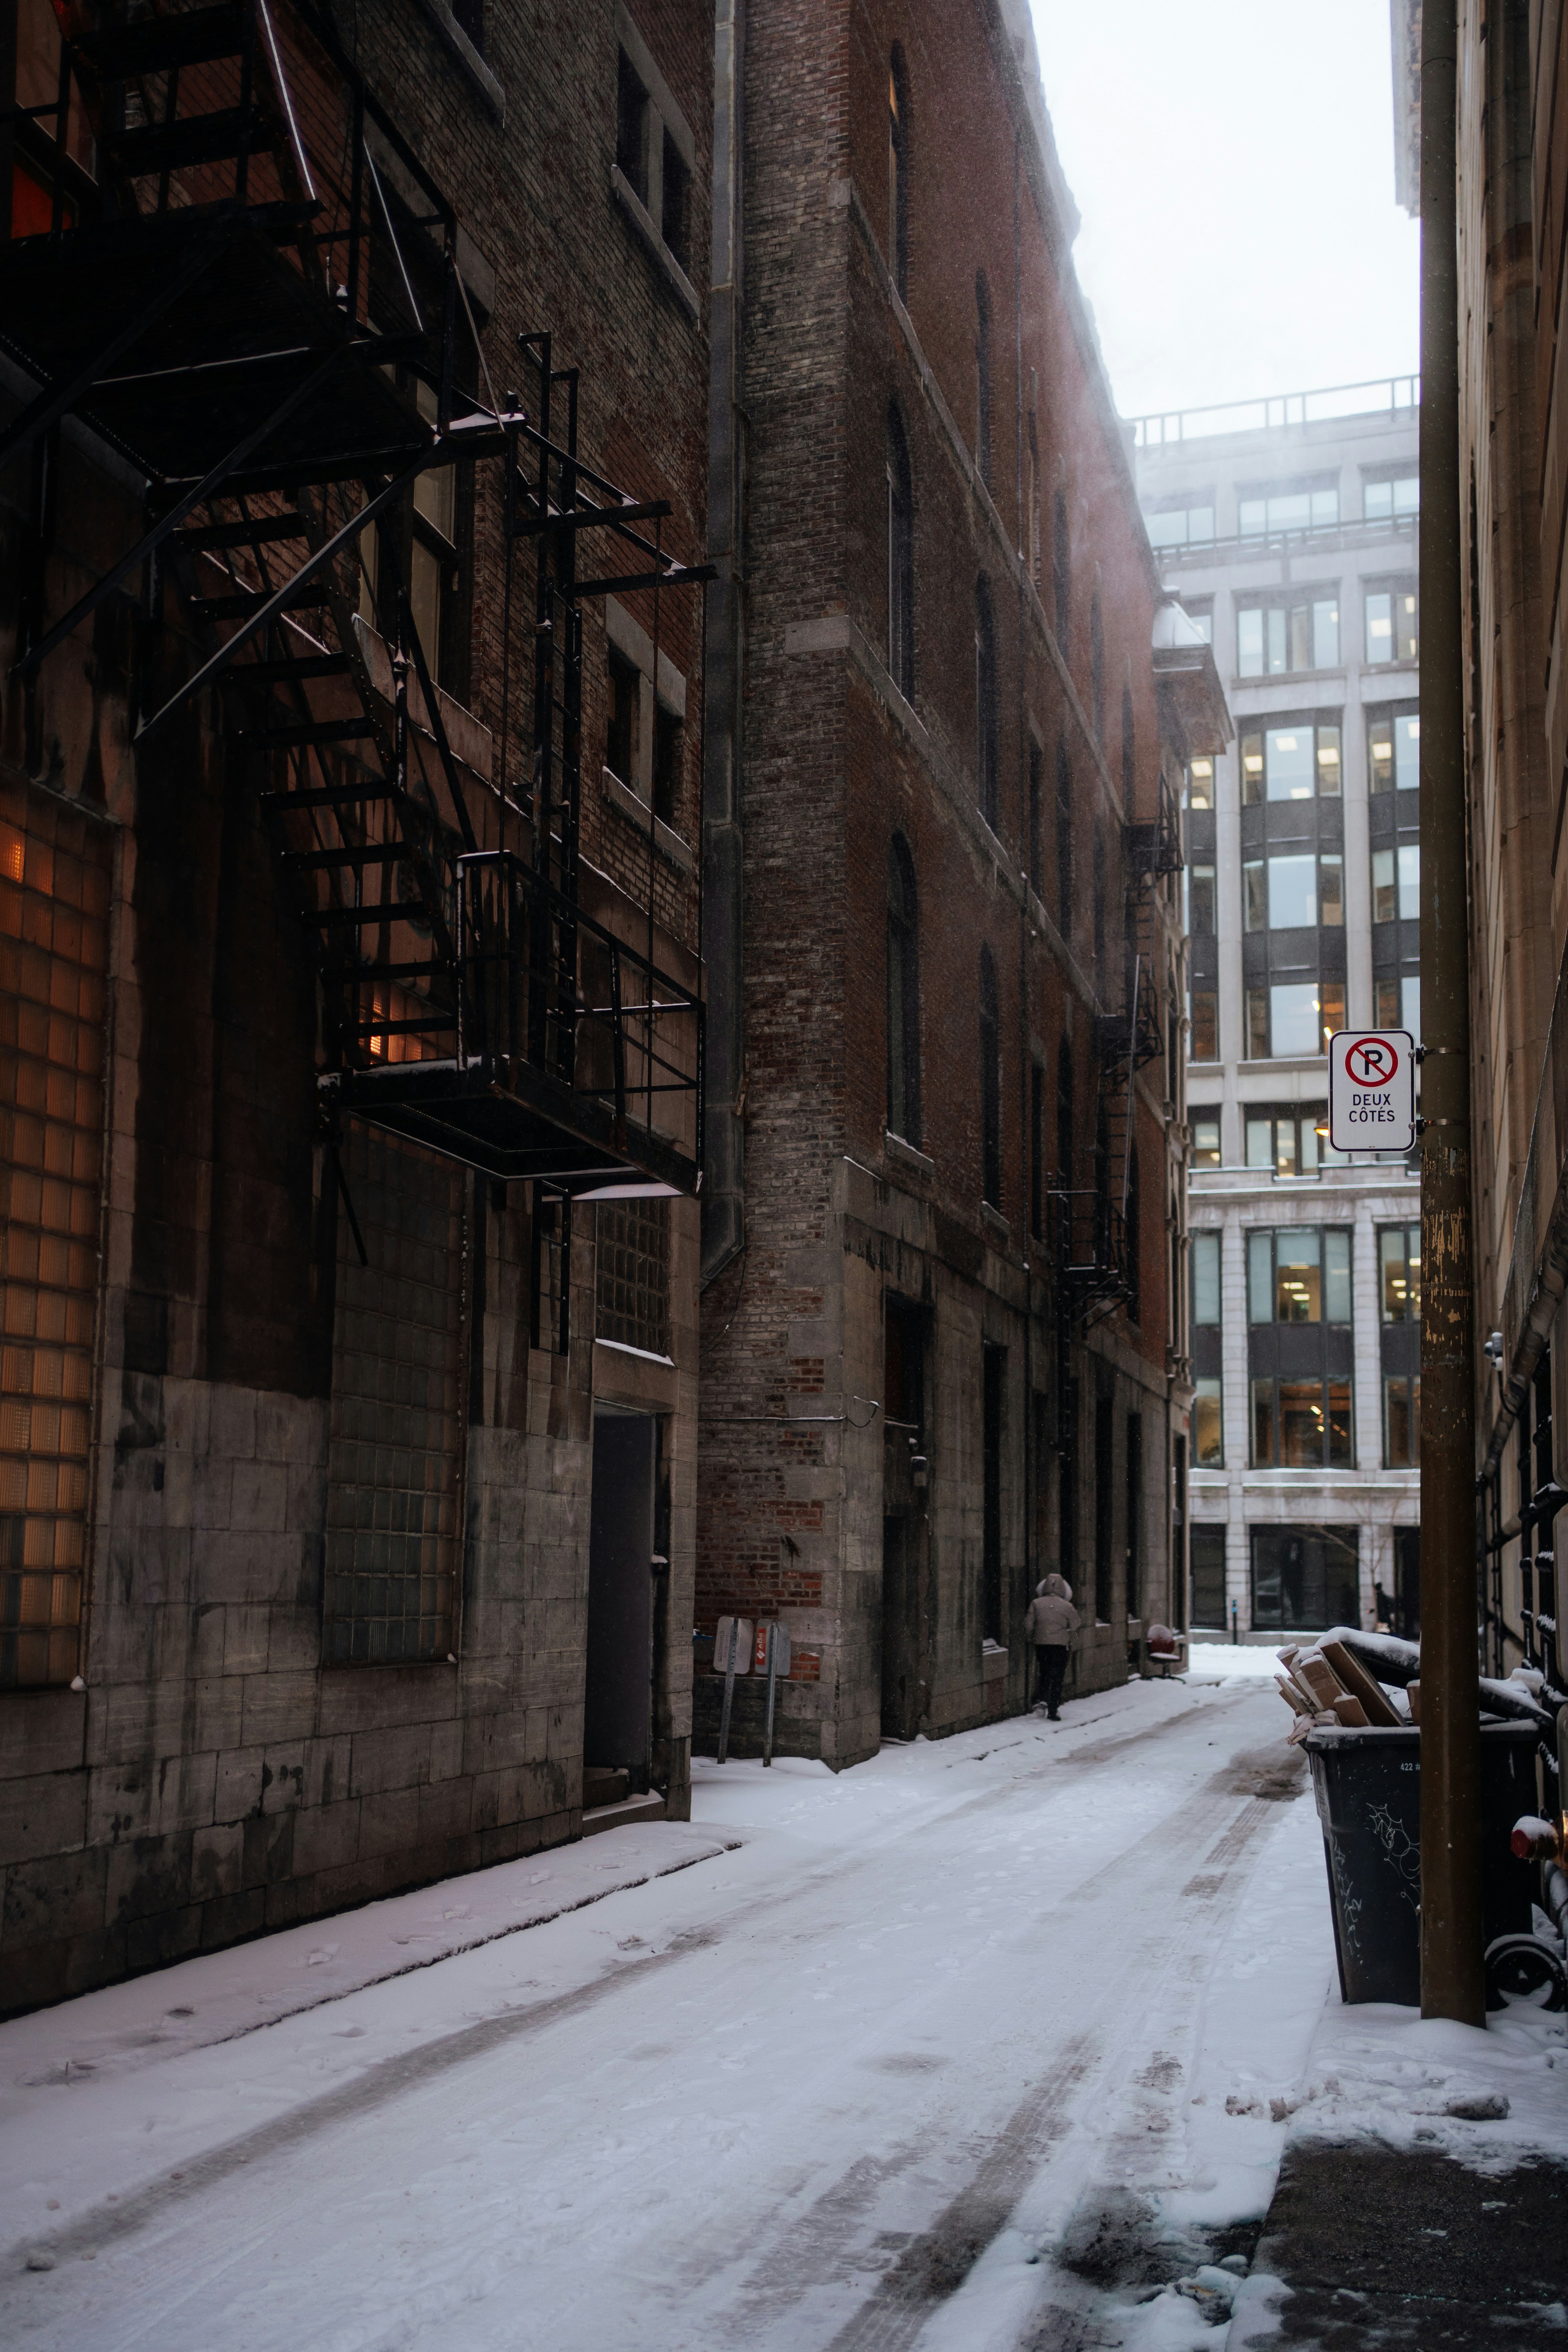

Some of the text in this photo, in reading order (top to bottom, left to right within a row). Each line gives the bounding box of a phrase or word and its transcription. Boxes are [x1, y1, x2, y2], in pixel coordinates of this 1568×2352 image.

[1365, 1050, 1383, 1075] P
[1353, 1094, 1391, 1106] DEUX
[1349, 1107, 1395, 1122] CÔTÉS
